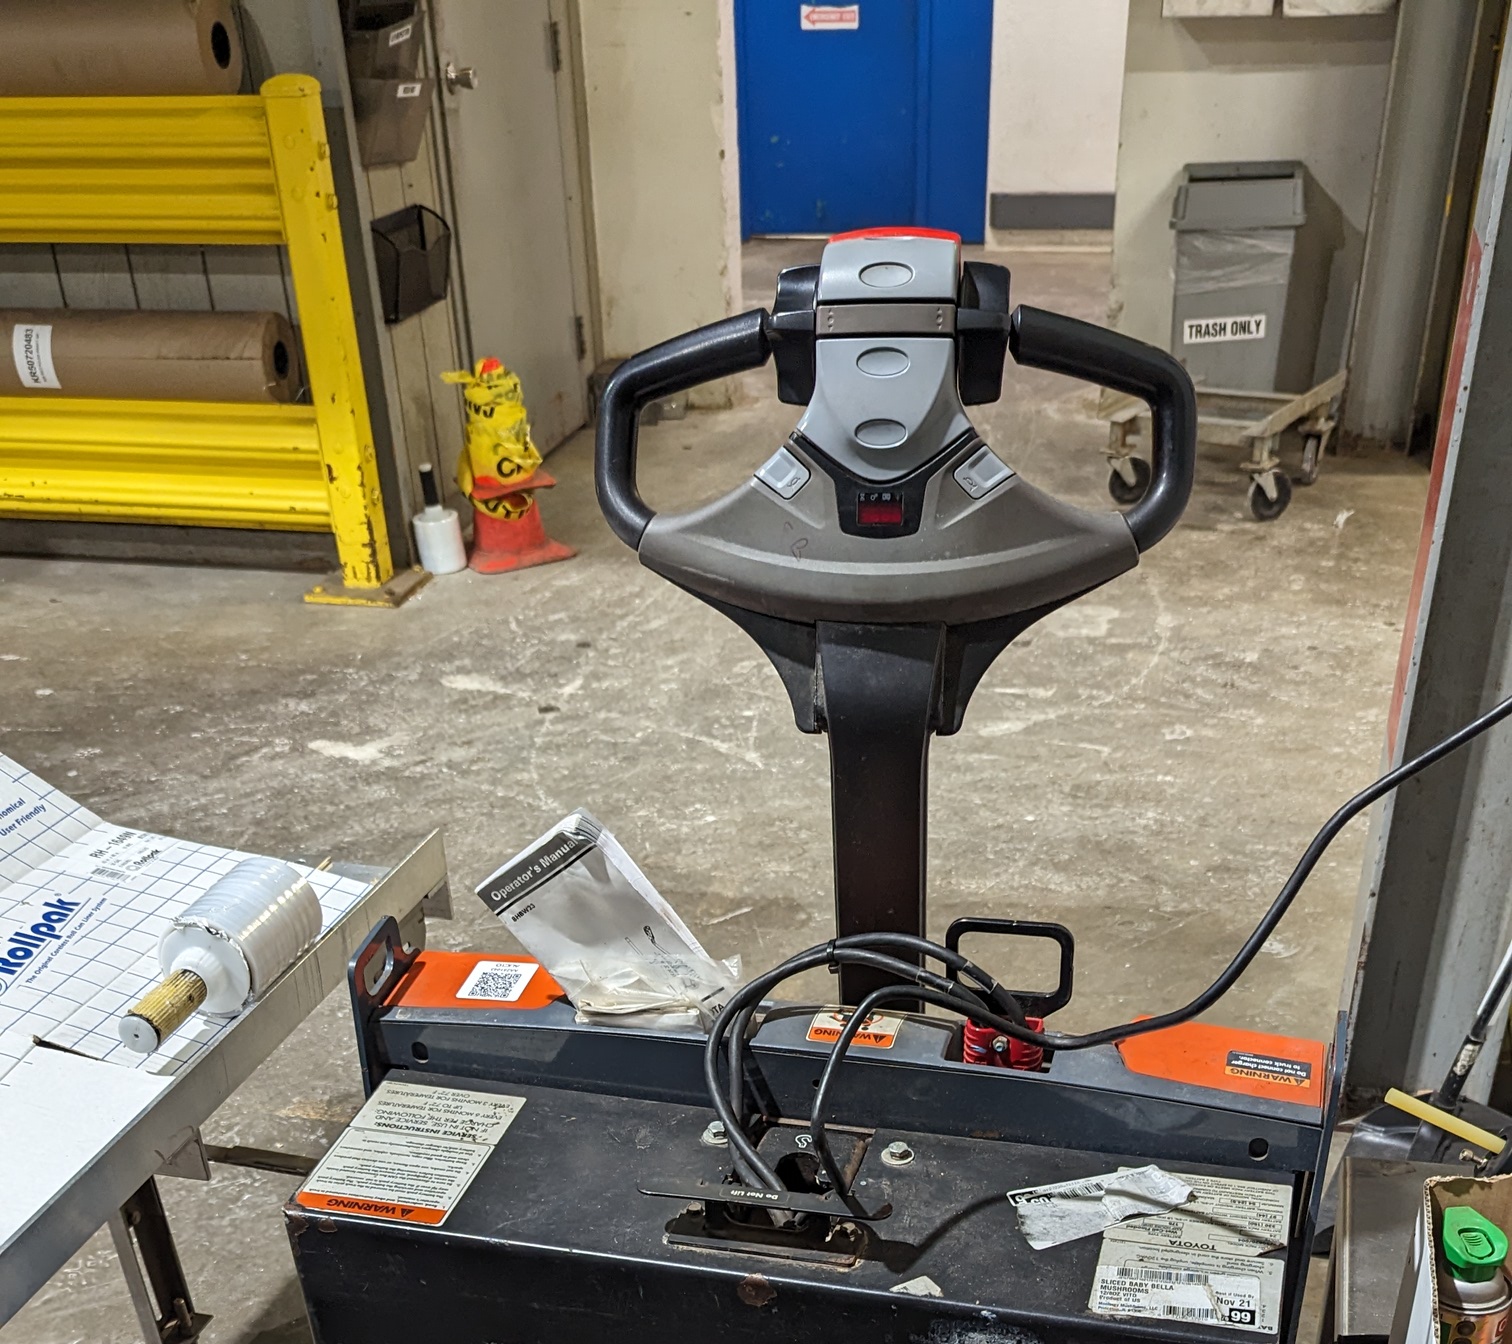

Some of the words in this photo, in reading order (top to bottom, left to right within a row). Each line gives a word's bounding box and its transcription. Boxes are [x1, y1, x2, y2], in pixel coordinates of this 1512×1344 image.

[1188, 322, 1227, 340] TRASH
[1230, 319, 1262, 336] ONLY
[0, 822, 18, 837] User
[15, 803, 47, 827] Friendly
[490, 864, 542, 901] Operator's
[538, 839, 580, 869] Manual
[0, 898, 82, 976] Rollpak
[25, 975, 37, 984] The
[814, 1029, 871, 1040] WANING
[1230, 1060, 1257, 1069] charger
[1258, 1064, 1283, 1073] connect
[1274, 1061, 1292, 1069] truck
[1230, 1068, 1292, 1084] WARNING
[386, 1089, 435, 1100] TEMPERATURES
[378, 1100, 426, 1111] TEMPERATURES
[452, 1097, 482, 1105] MONTHS
[375, 1109, 426, 1120] FOLLOWING:
[443, 1108, 474, 1116] MONTHS
[395, 1117, 428, 1126] SERVICE
[460, 1119, 494, 1128] CHARGE
[374, 1122, 440, 1135] INSTRUCTIONS:
[441, 1130, 476, 1139] SERVICE
[730, 1189, 746, 1198] Lift
[749, 1191, 764, 1199] Not
[765, 1192, 779, 1200] Do
[326, 1199, 397, 1214] WARNING
[1168, 1239, 1216, 1251] TOYOTA
[1160, 1248, 1190, 1257] designated
[1100, 1285, 1149, 1294] MUSHROOMS
[1151, 1283, 1174, 1291] BELLA
[1216, 1297, 1236, 1306] Nov
[1230, 1310, 1251, 1323] 99
